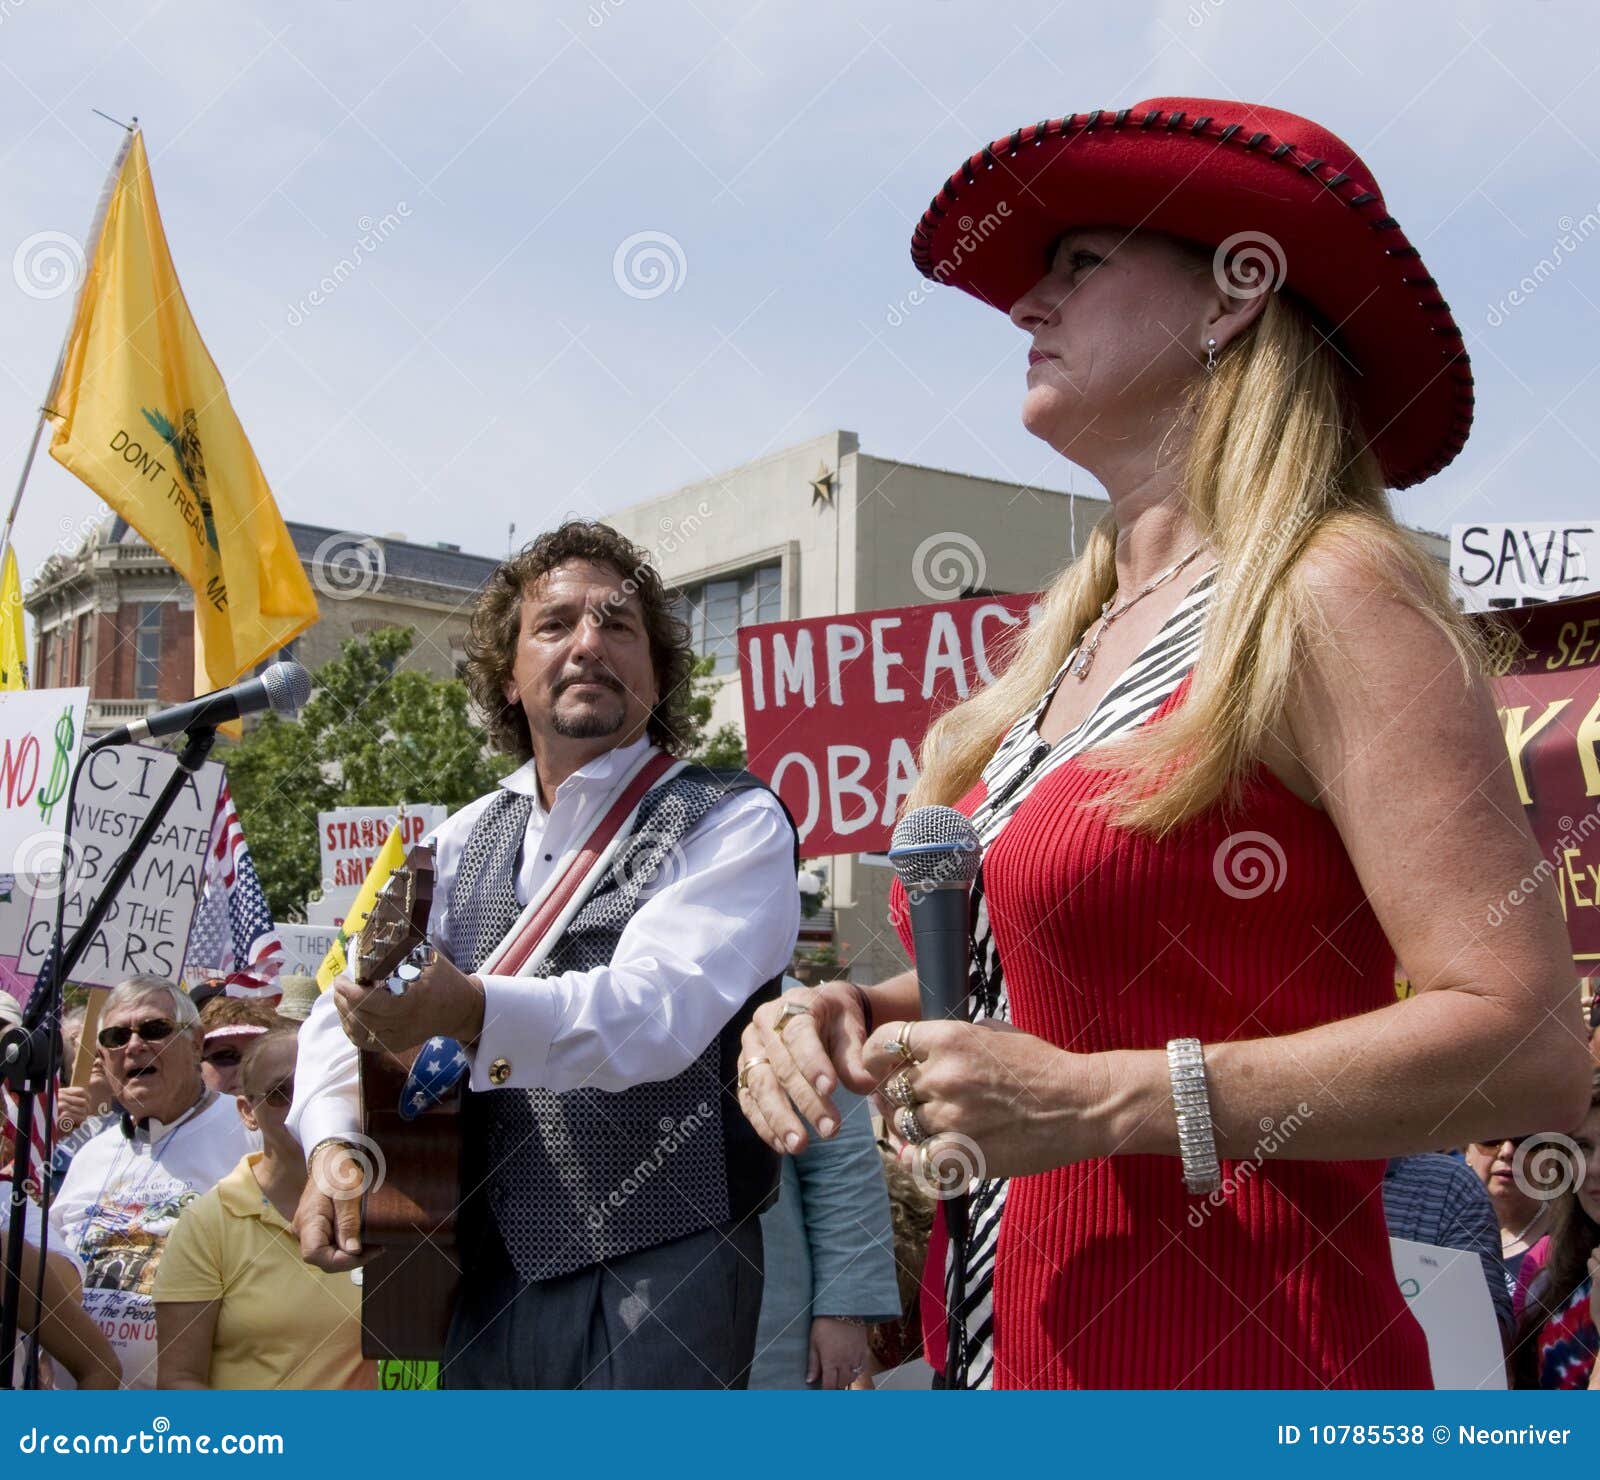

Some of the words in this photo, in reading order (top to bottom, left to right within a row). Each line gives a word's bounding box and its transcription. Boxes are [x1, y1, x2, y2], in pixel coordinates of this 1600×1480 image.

[109, 430, 166, 482] DONT
[206, 575, 229, 613] ME
[1459, 527, 1595, 587] SAVE
[749, 604, 1043, 711] IMPEAC
[0, 732, 40, 809] NO
[769, 738, 922, 845] OBA
[326, 818, 389, 851] STAND
[401, 815, 425, 845] UP
[127, 901, 174, 935] THE
[99, 1303, 120, 1319] the
[122, 1306, 157, 1324] Peop
[118, 1322, 141, 1340] ON
